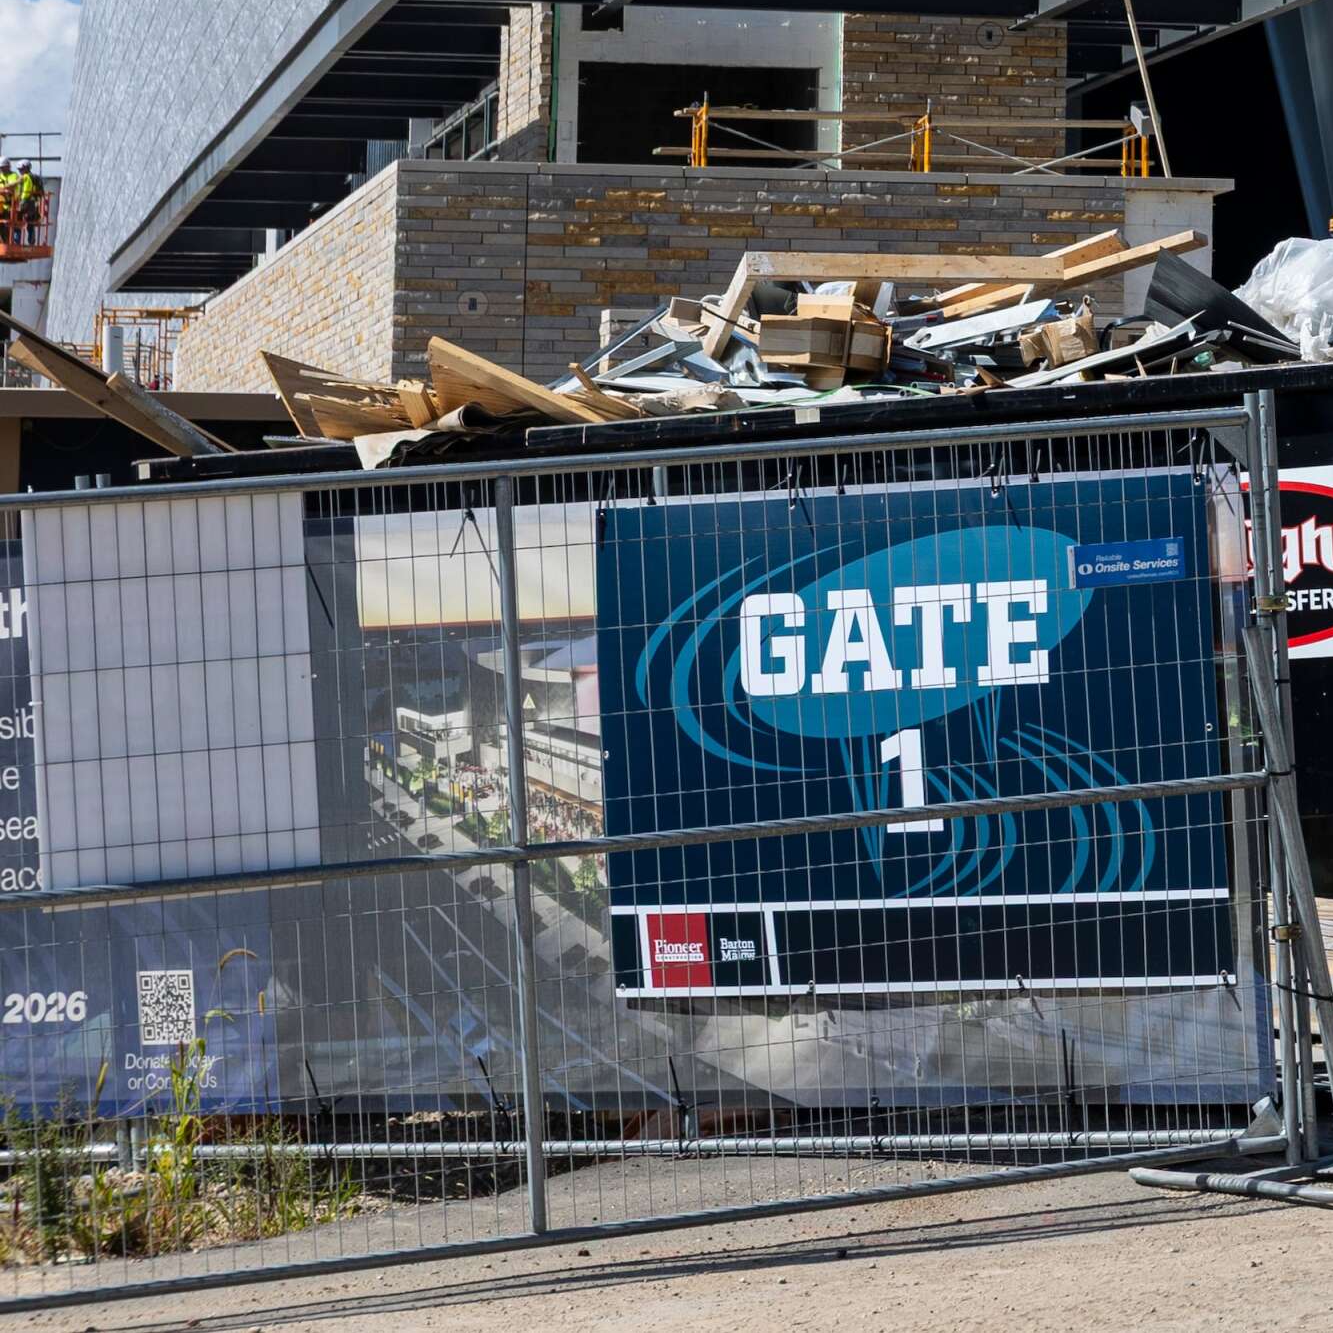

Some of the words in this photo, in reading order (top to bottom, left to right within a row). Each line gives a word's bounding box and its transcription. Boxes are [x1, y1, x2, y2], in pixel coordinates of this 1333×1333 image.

[1095, 561, 1130, 573] Onsite
[1133, 558, 1179, 570] Services
[739, 579, 1050, 697] GATE
[880, 729, 945, 833] 1
[654, 939, 703, 954] Pioneer
[720, 937, 755, 950] Barton
[128, 1077, 142, 1090] or
